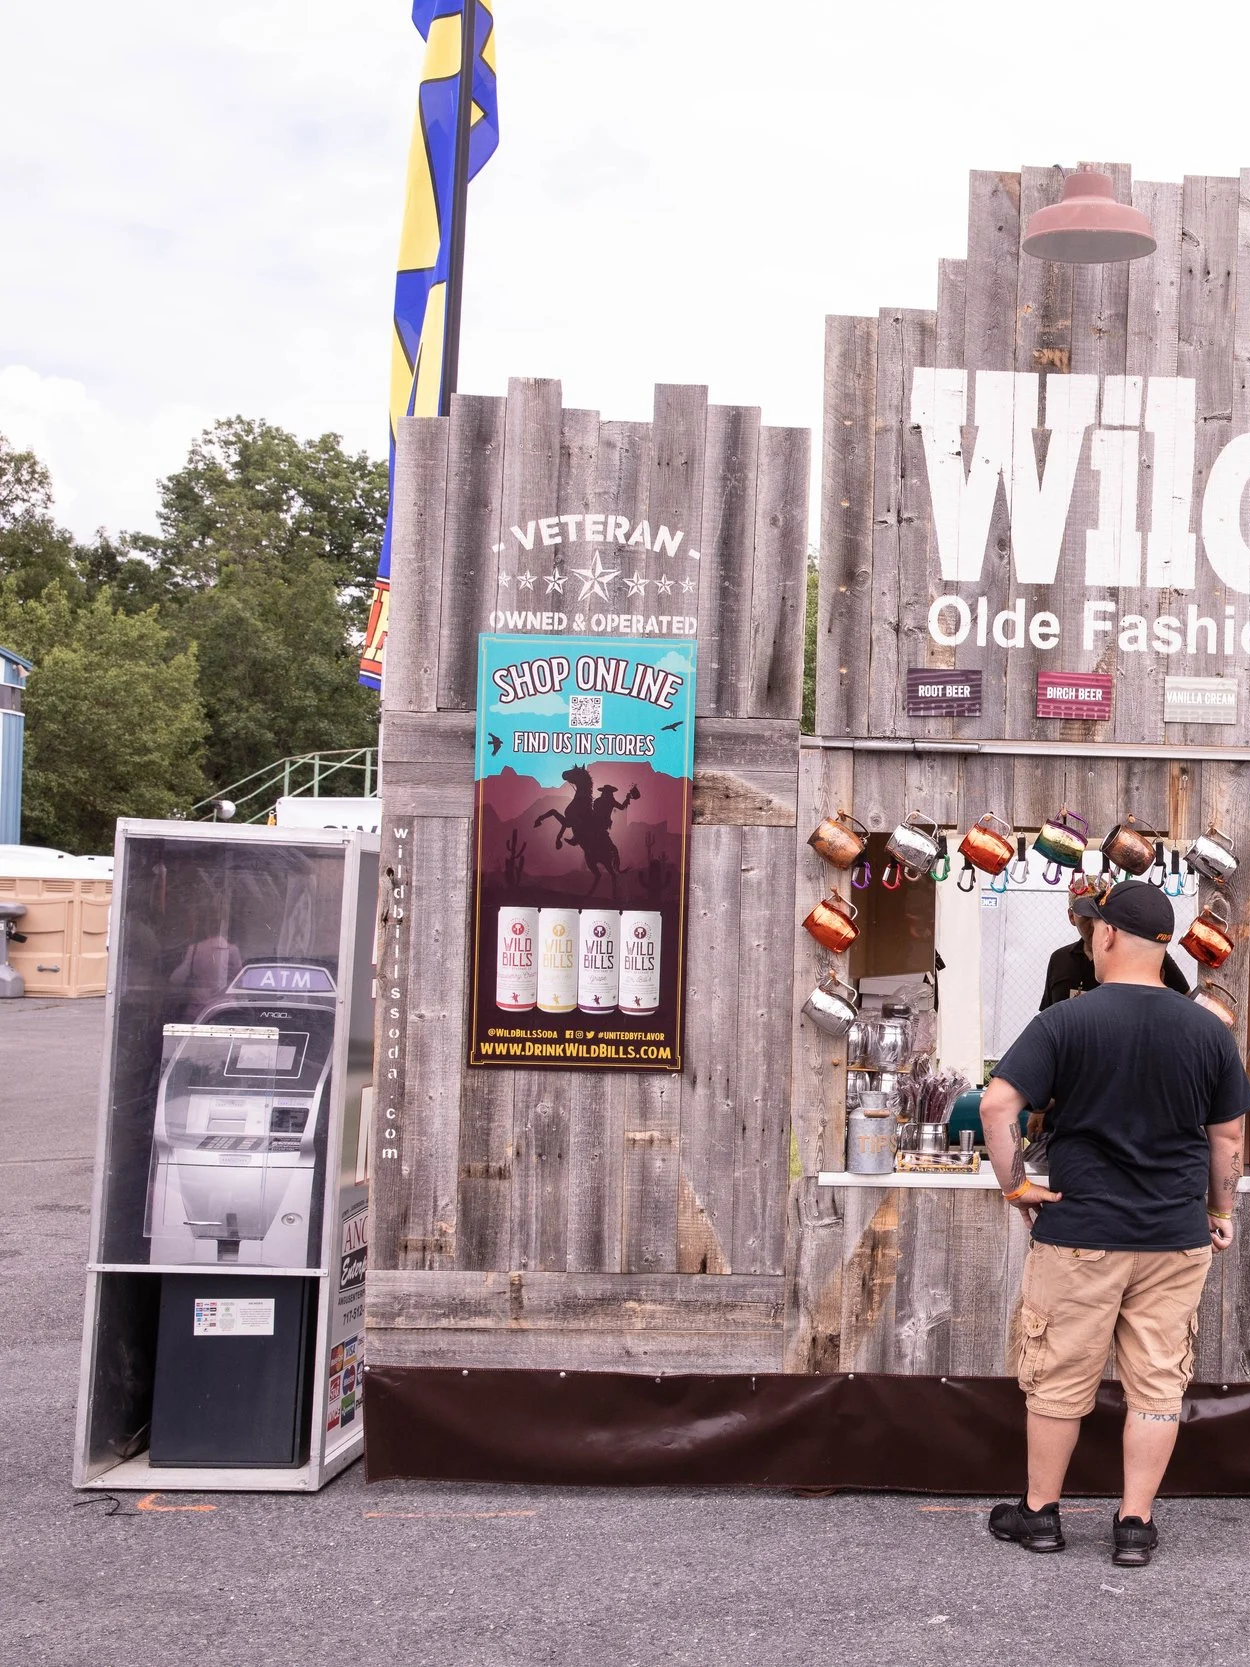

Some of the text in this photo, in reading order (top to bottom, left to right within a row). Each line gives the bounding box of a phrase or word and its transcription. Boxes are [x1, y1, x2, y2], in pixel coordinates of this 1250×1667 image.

[510, 514, 685, 558] VETERAN
[490, 611, 697, 636] OWNED & OPERATED
[927, 595, 1060, 650] Olde
[493, 656, 683, 709] SHOP ONLINE
[918, 684, 970, 698] ROOT BEER
[1047, 686, 1103, 701] BIRCH BEER
[1166, 691, 1235, 706] VANILLA CREAM
[513, 731, 655, 756] FIND US IN STORES
[504, 936, 532, 953] WILD
[545, 938, 572, 954] WILD
[585, 939, 613, 956] WILD
[625, 941, 654, 956] WILD
[260, 970, 311, 988] ATM
[382, 827, 409, 1160] wildbillssoda.com
